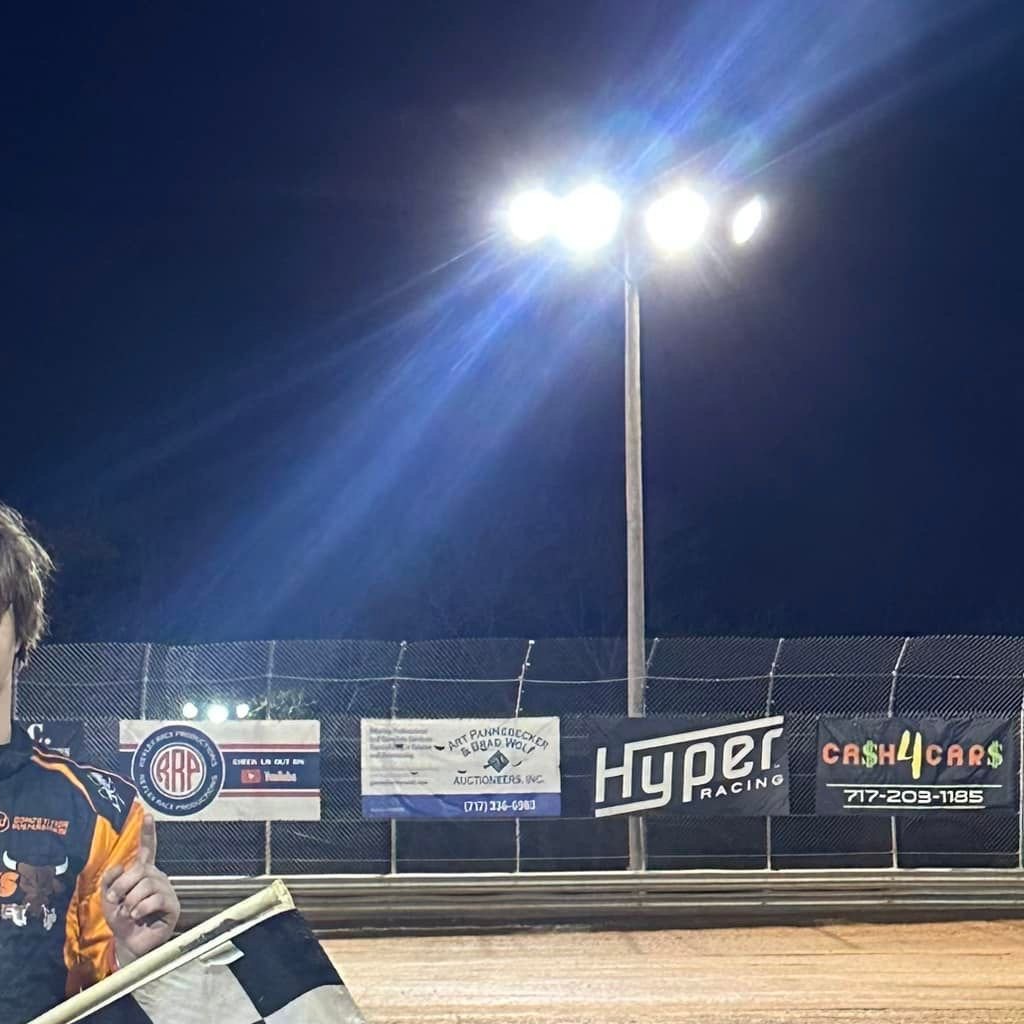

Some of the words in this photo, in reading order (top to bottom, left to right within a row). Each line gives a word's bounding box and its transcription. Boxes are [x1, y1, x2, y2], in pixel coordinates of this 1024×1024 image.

[448, 734, 468, 751] ART
[155, 748, 201, 793] RRP
[700, 774, 784, 800] RACING
[843, 789, 984, 803] 717-203-1185
